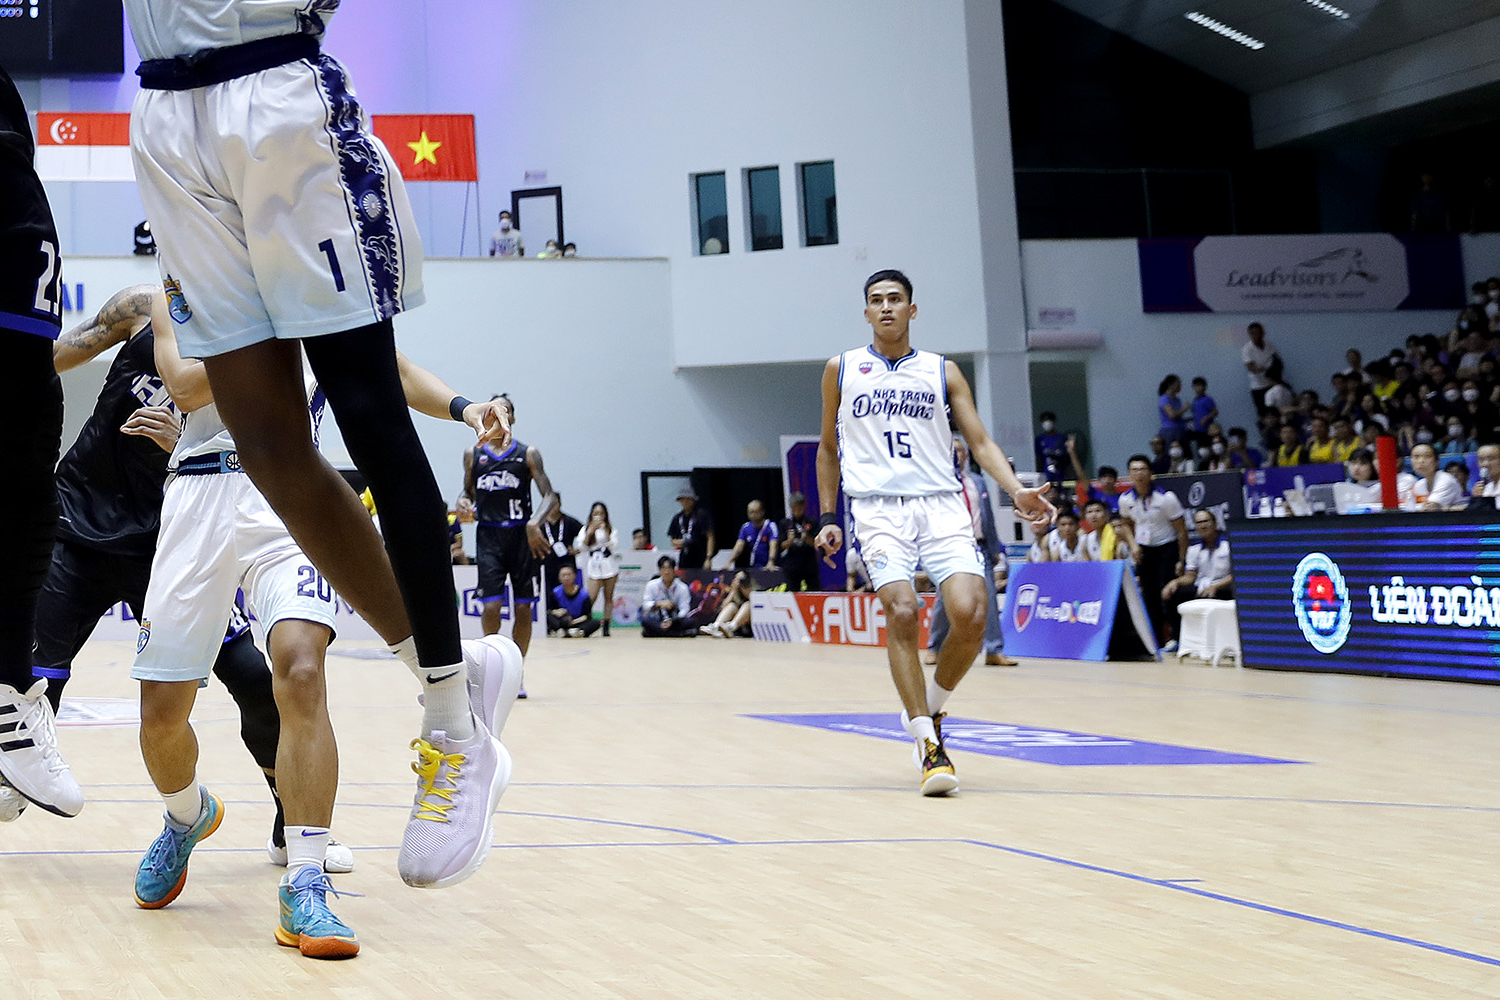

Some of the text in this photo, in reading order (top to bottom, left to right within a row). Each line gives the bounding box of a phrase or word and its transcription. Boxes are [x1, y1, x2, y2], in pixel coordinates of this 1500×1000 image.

[318, 238, 346, 292] 1
[1226, 265, 1337, 288] Leadvisors
[852, 393, 935, 421] Dolphins
[873, 388, 896, 399] NHA
[883, 431, 912, 459] 15
[508, 499, 524, 520] 15
[296, 565, 332, 603] 20
